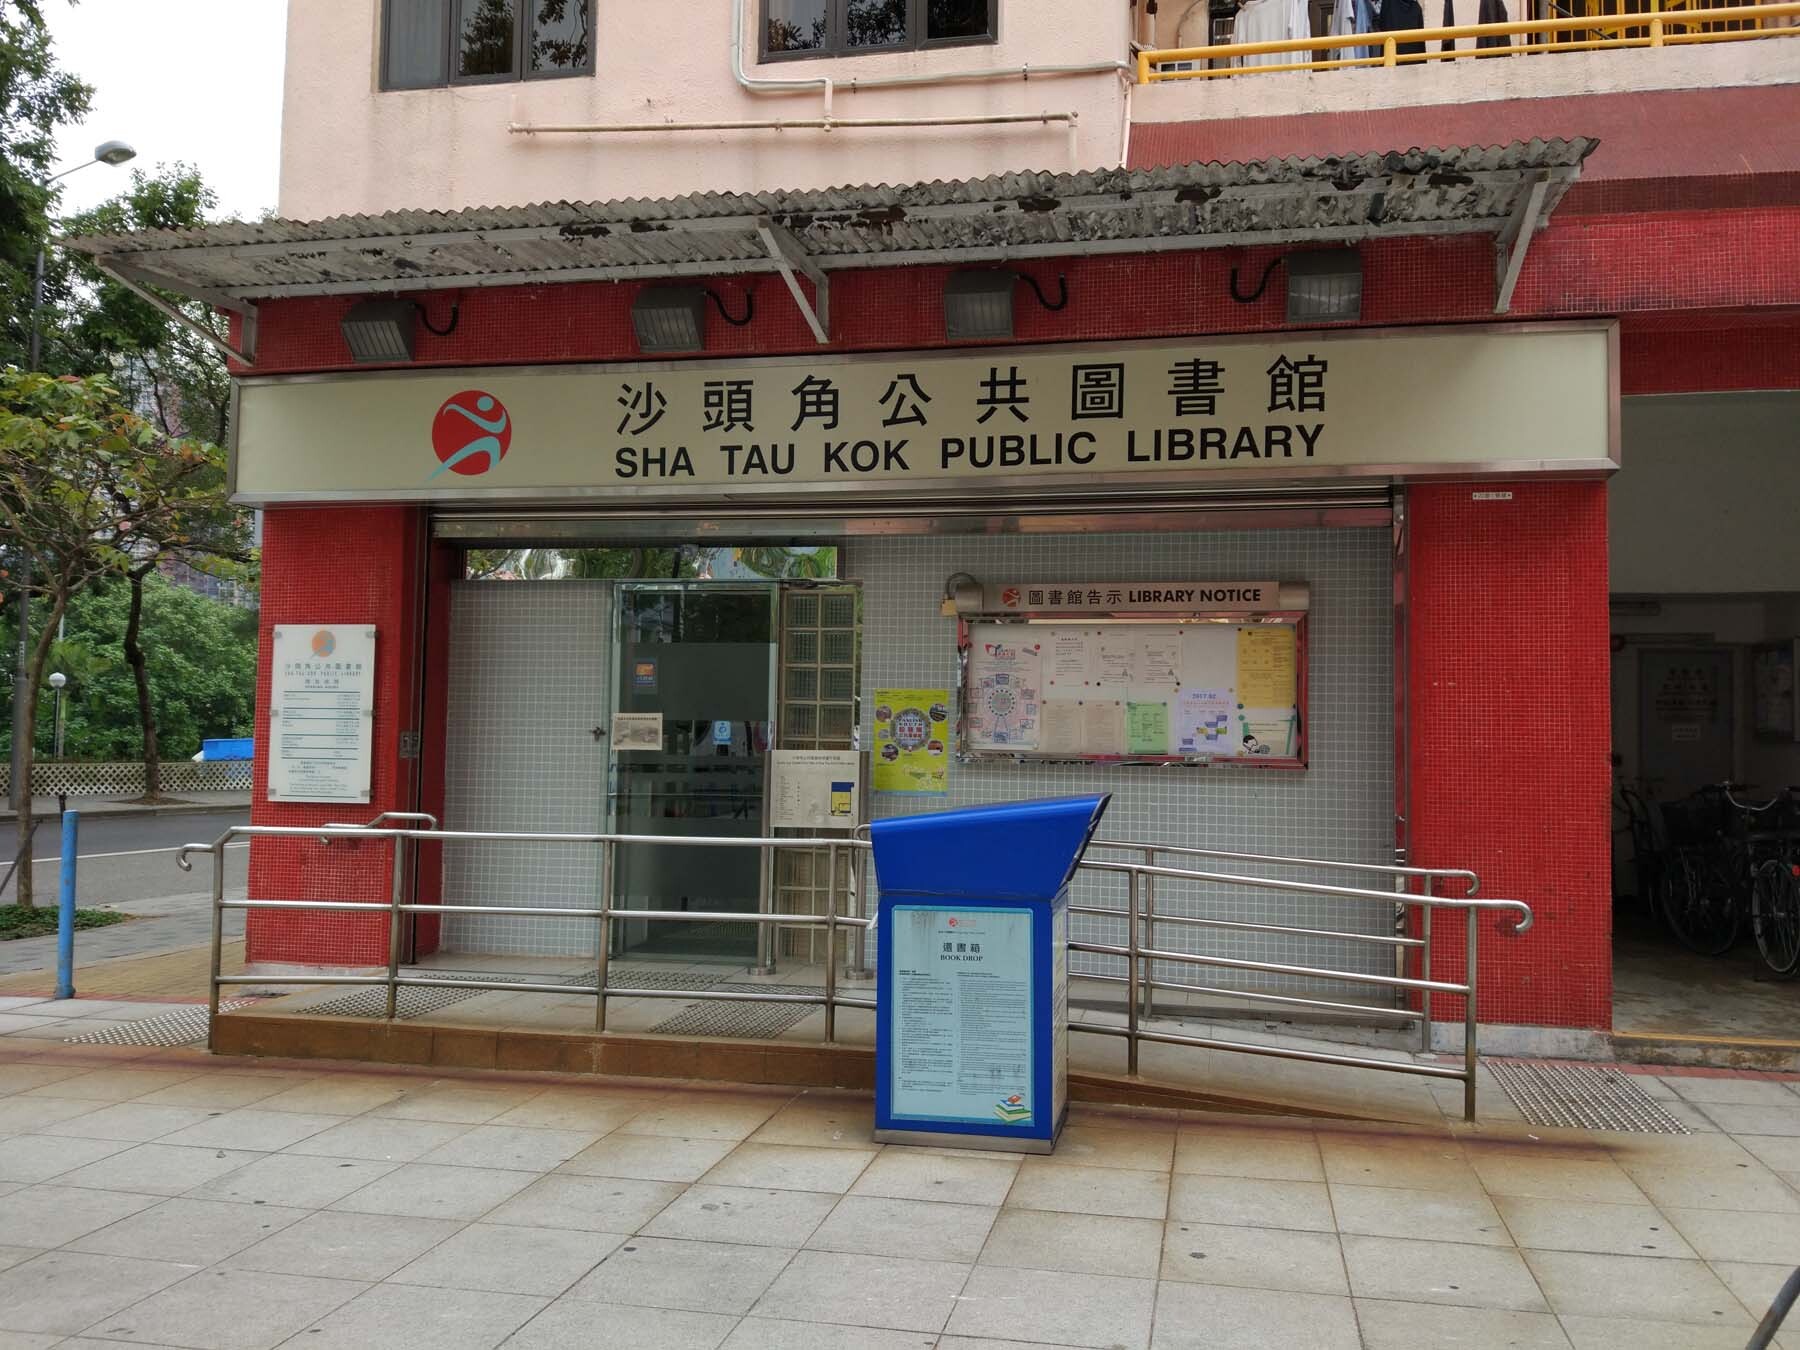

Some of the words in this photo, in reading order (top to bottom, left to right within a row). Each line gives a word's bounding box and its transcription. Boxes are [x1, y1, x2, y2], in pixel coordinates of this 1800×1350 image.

[616, 354, 1328, 436] 沙頭角公共圖書館
[615, 447, 695, 478] SHA
[720, 443, 795, 475] TAU
[824, 439, 910, 473] KOK
[941, 431, 1097, 469] PUBLIC
[1127, 424, 1325, 462] LIBRARY
[1028, 590, 1123, 605] 圖書館告示
[1128, 589, 1195, 603] LIBRARY
[1200, 589, 1261, 602] NOTICE
[943, 942, 981, 953] 還書箱
